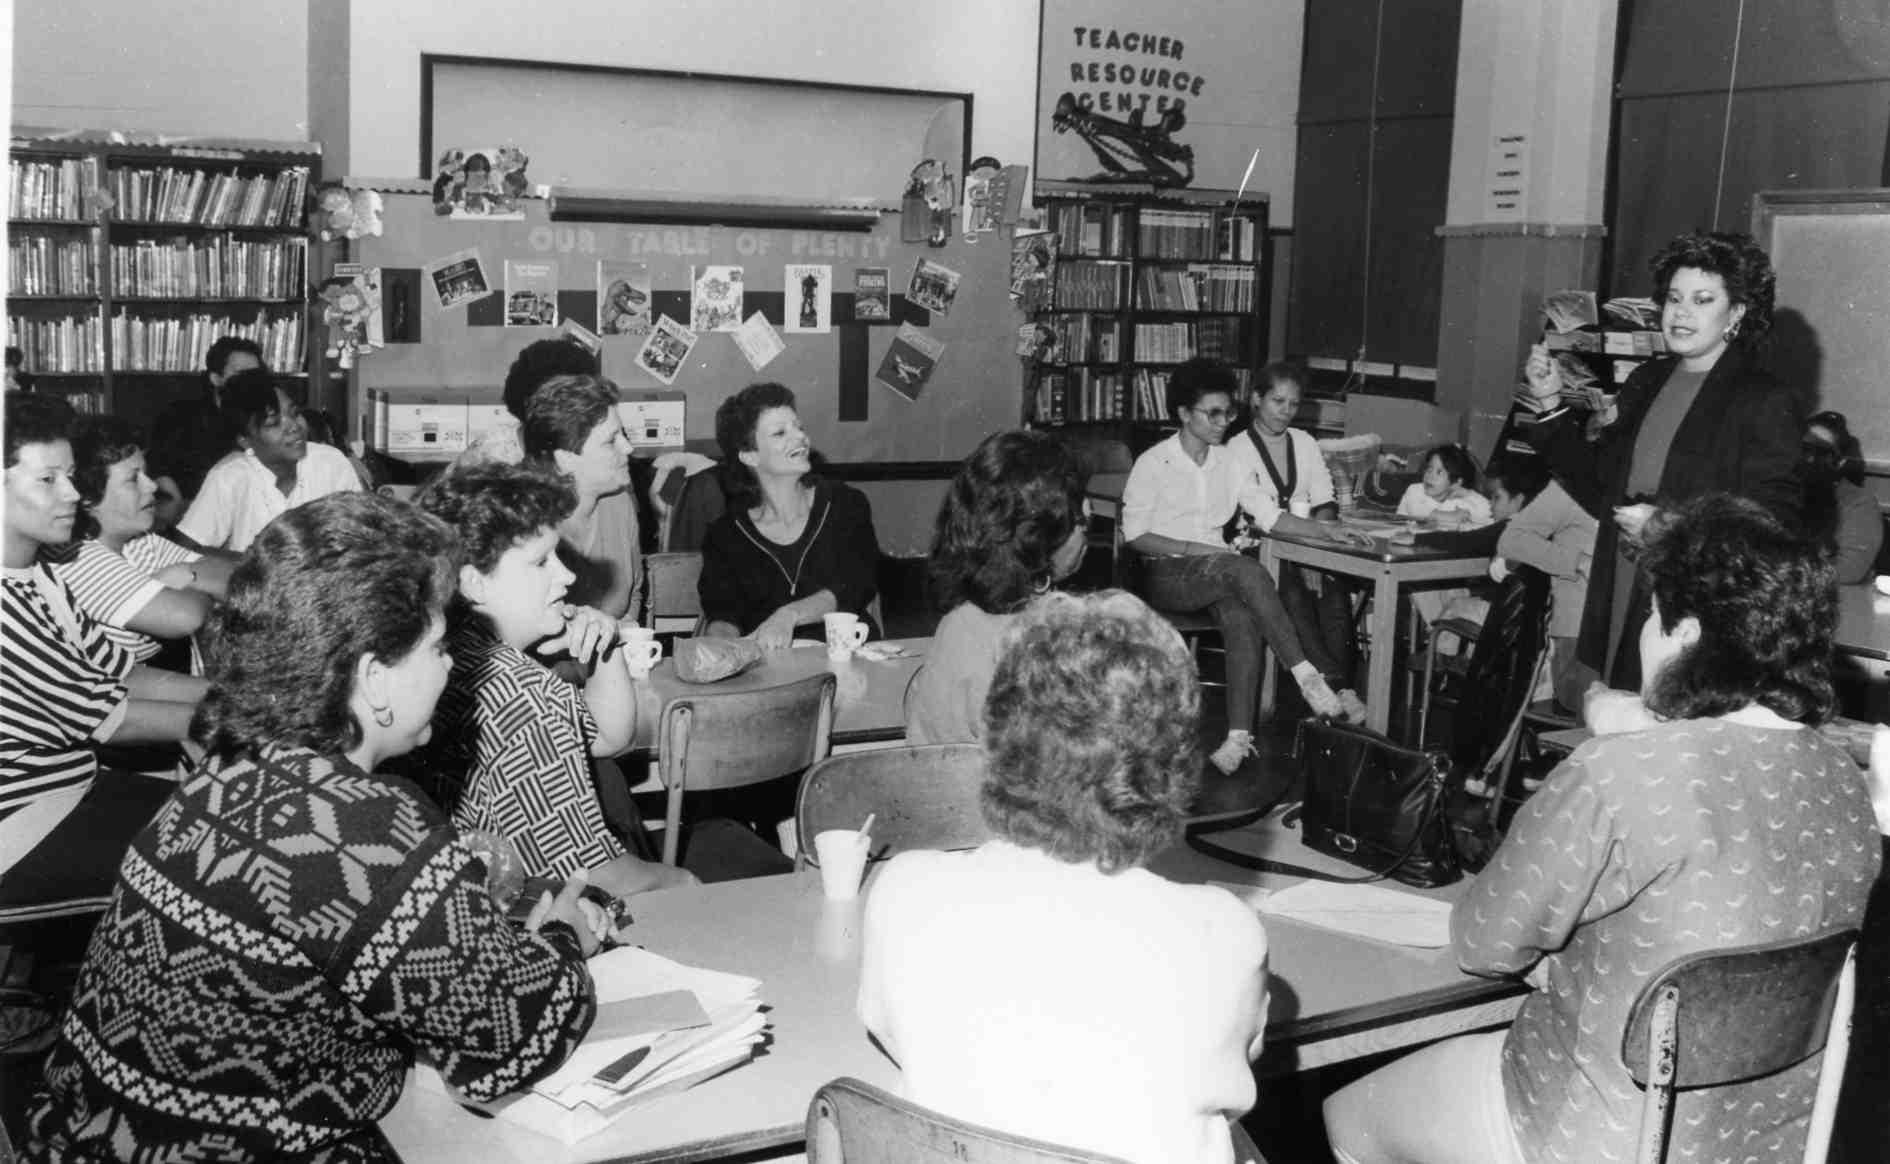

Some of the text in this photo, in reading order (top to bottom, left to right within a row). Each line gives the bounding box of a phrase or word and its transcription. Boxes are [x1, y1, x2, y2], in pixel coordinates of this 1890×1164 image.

[1073, 27, 1184, 60] TEACHER
[1070, 62, 1205, 97] RESOURCE
[528, 226, 891, 259] OUR TABLE OF PLENTY
